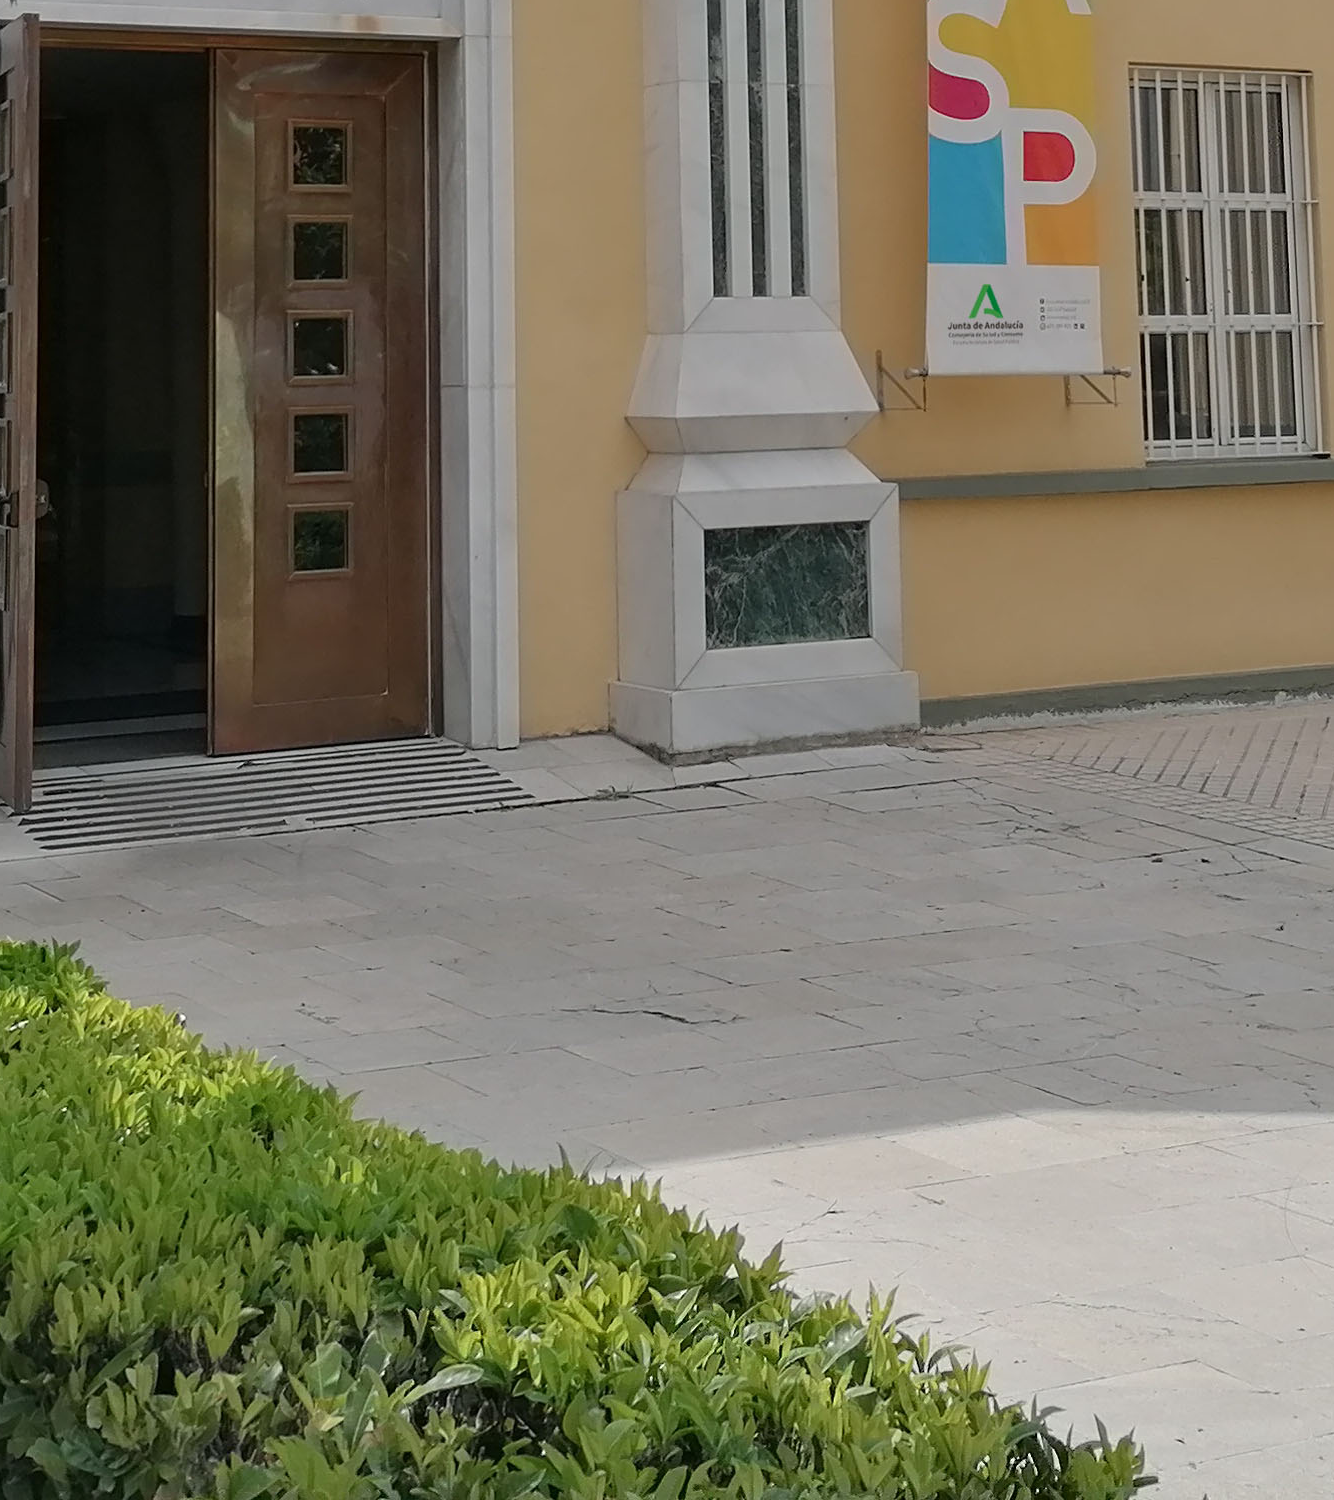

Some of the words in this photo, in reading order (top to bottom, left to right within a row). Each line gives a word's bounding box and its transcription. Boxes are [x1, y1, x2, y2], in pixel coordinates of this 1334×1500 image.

[947, 321, 972, 331] Junta
[973, 321, 983, 330] de
[984, 320, 1024, 330] Andalucía
